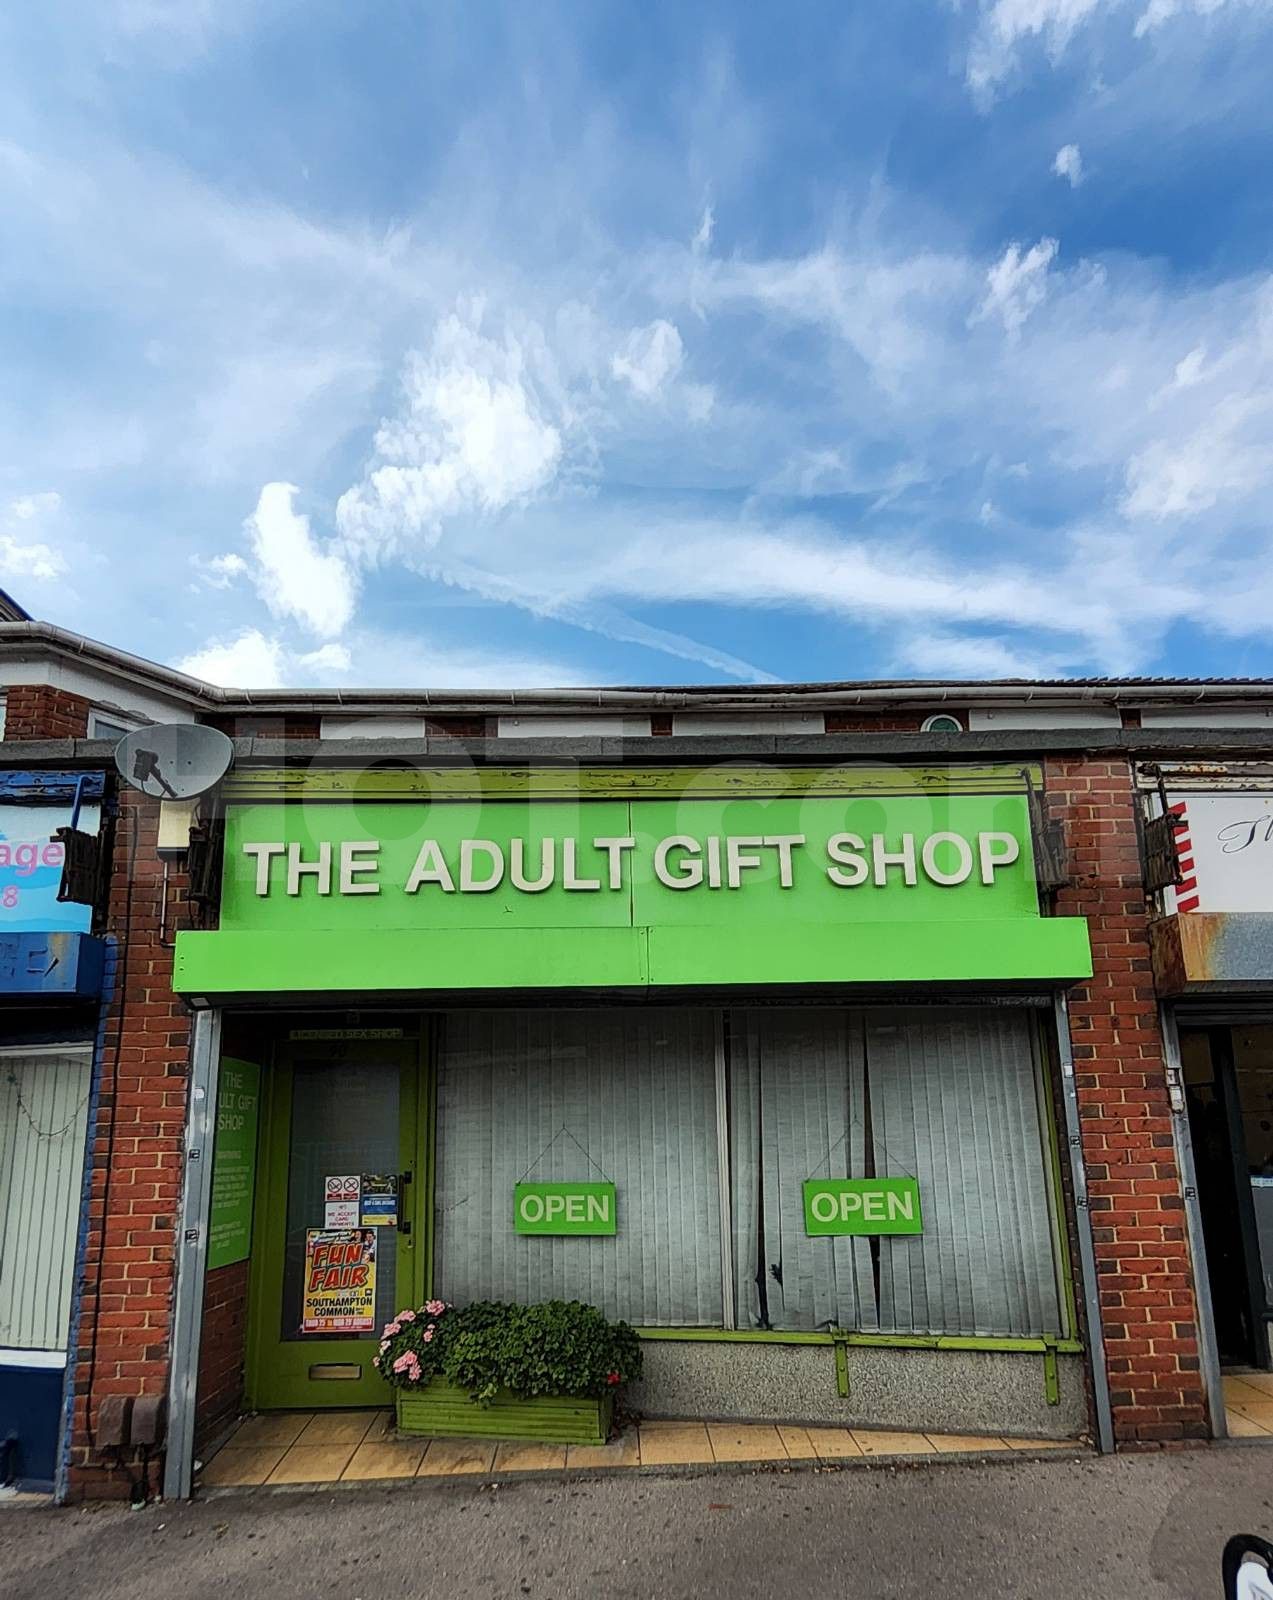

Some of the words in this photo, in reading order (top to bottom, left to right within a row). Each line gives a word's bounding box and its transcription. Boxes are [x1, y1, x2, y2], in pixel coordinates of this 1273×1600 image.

[1217, 814, 1273, 853] T
[242, 840, 381, 896] THE
[404, 837, 637, 893] ADULT
[654, 833, 806, 889] GIFT
[826, 831, 1020, 887] SHOP
[224, 1071, 243, 1089] THE
[237, 1094, 257, 1113] GIFT
[218, 1112, 244, 1131] SHOP
[520, 1194, 609, 1223] OPEN
[811, 1191, 914, 1223] OPEN
[312, 1243, 363, 1267] FUN
[309, 1265, 369, 1292] FAIR
[306, 1297, 372, 1308] SOUTHAMPTON
[314, 1307, 355, 1317] COMMON
